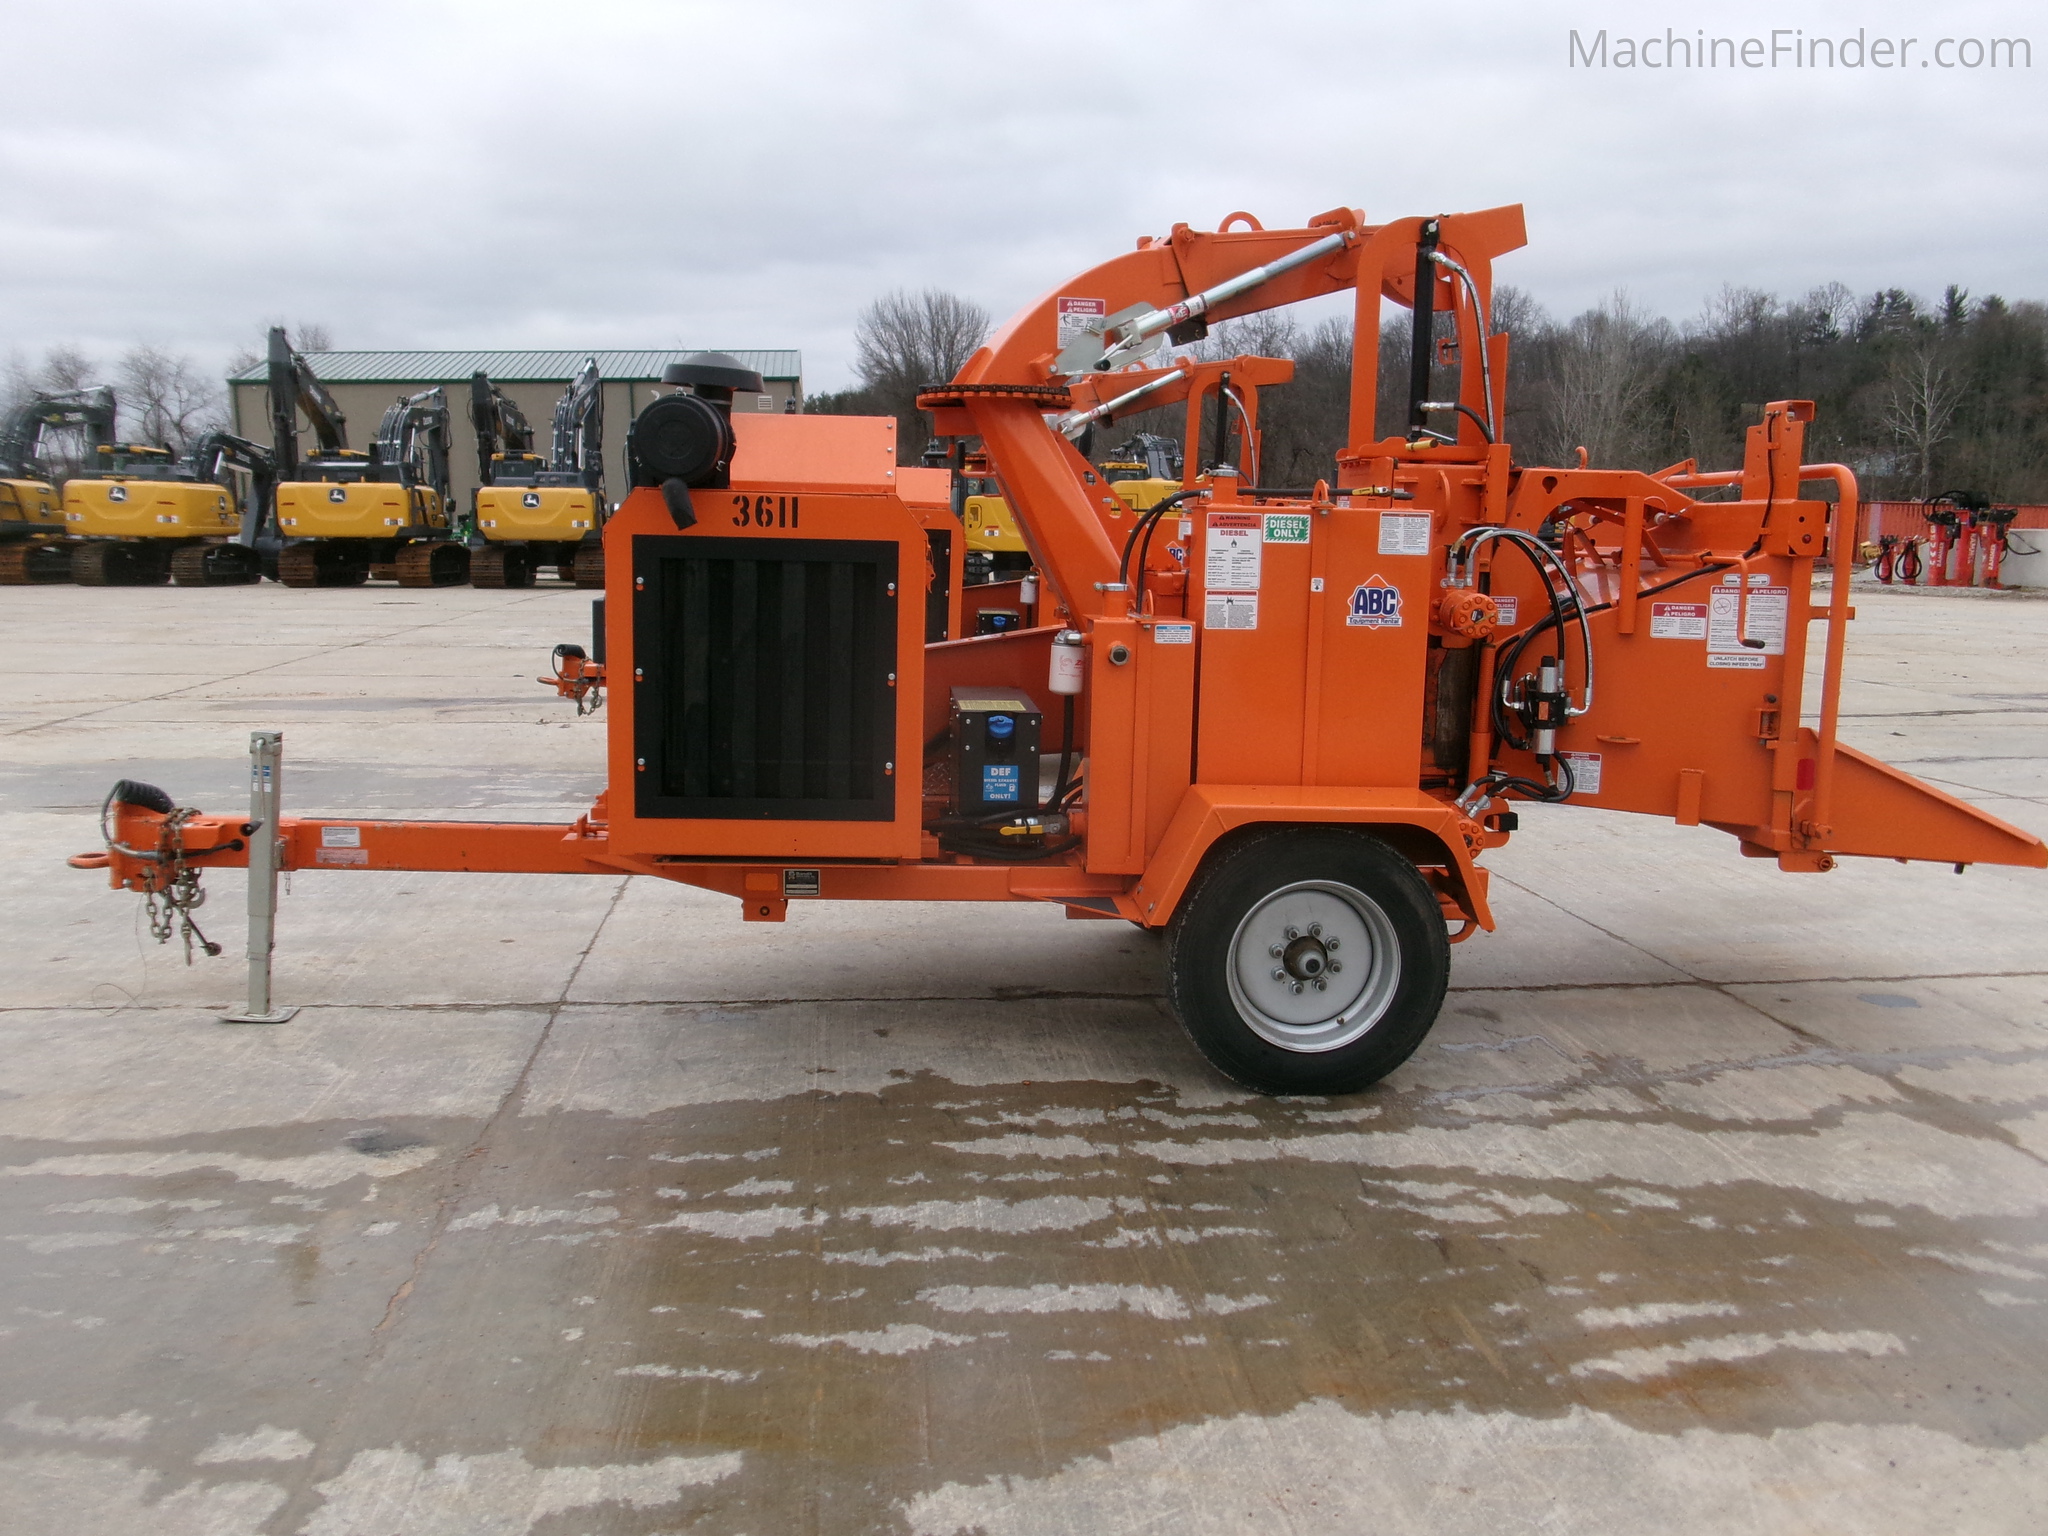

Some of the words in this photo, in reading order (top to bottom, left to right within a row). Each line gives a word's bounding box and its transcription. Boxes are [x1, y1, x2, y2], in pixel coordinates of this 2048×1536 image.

[732, 495, 799, 528] 3611
[1270, 519, 1305, 529] DIESEL
[1273, 529, 1300, 538] ONLY
[1353, 588, 1397, 616] ABC
[1349, 616, 1379, 624] Equipment
[1381, 616, 1400, 624] Rental
[990, 767, 1011, 776] DEF
